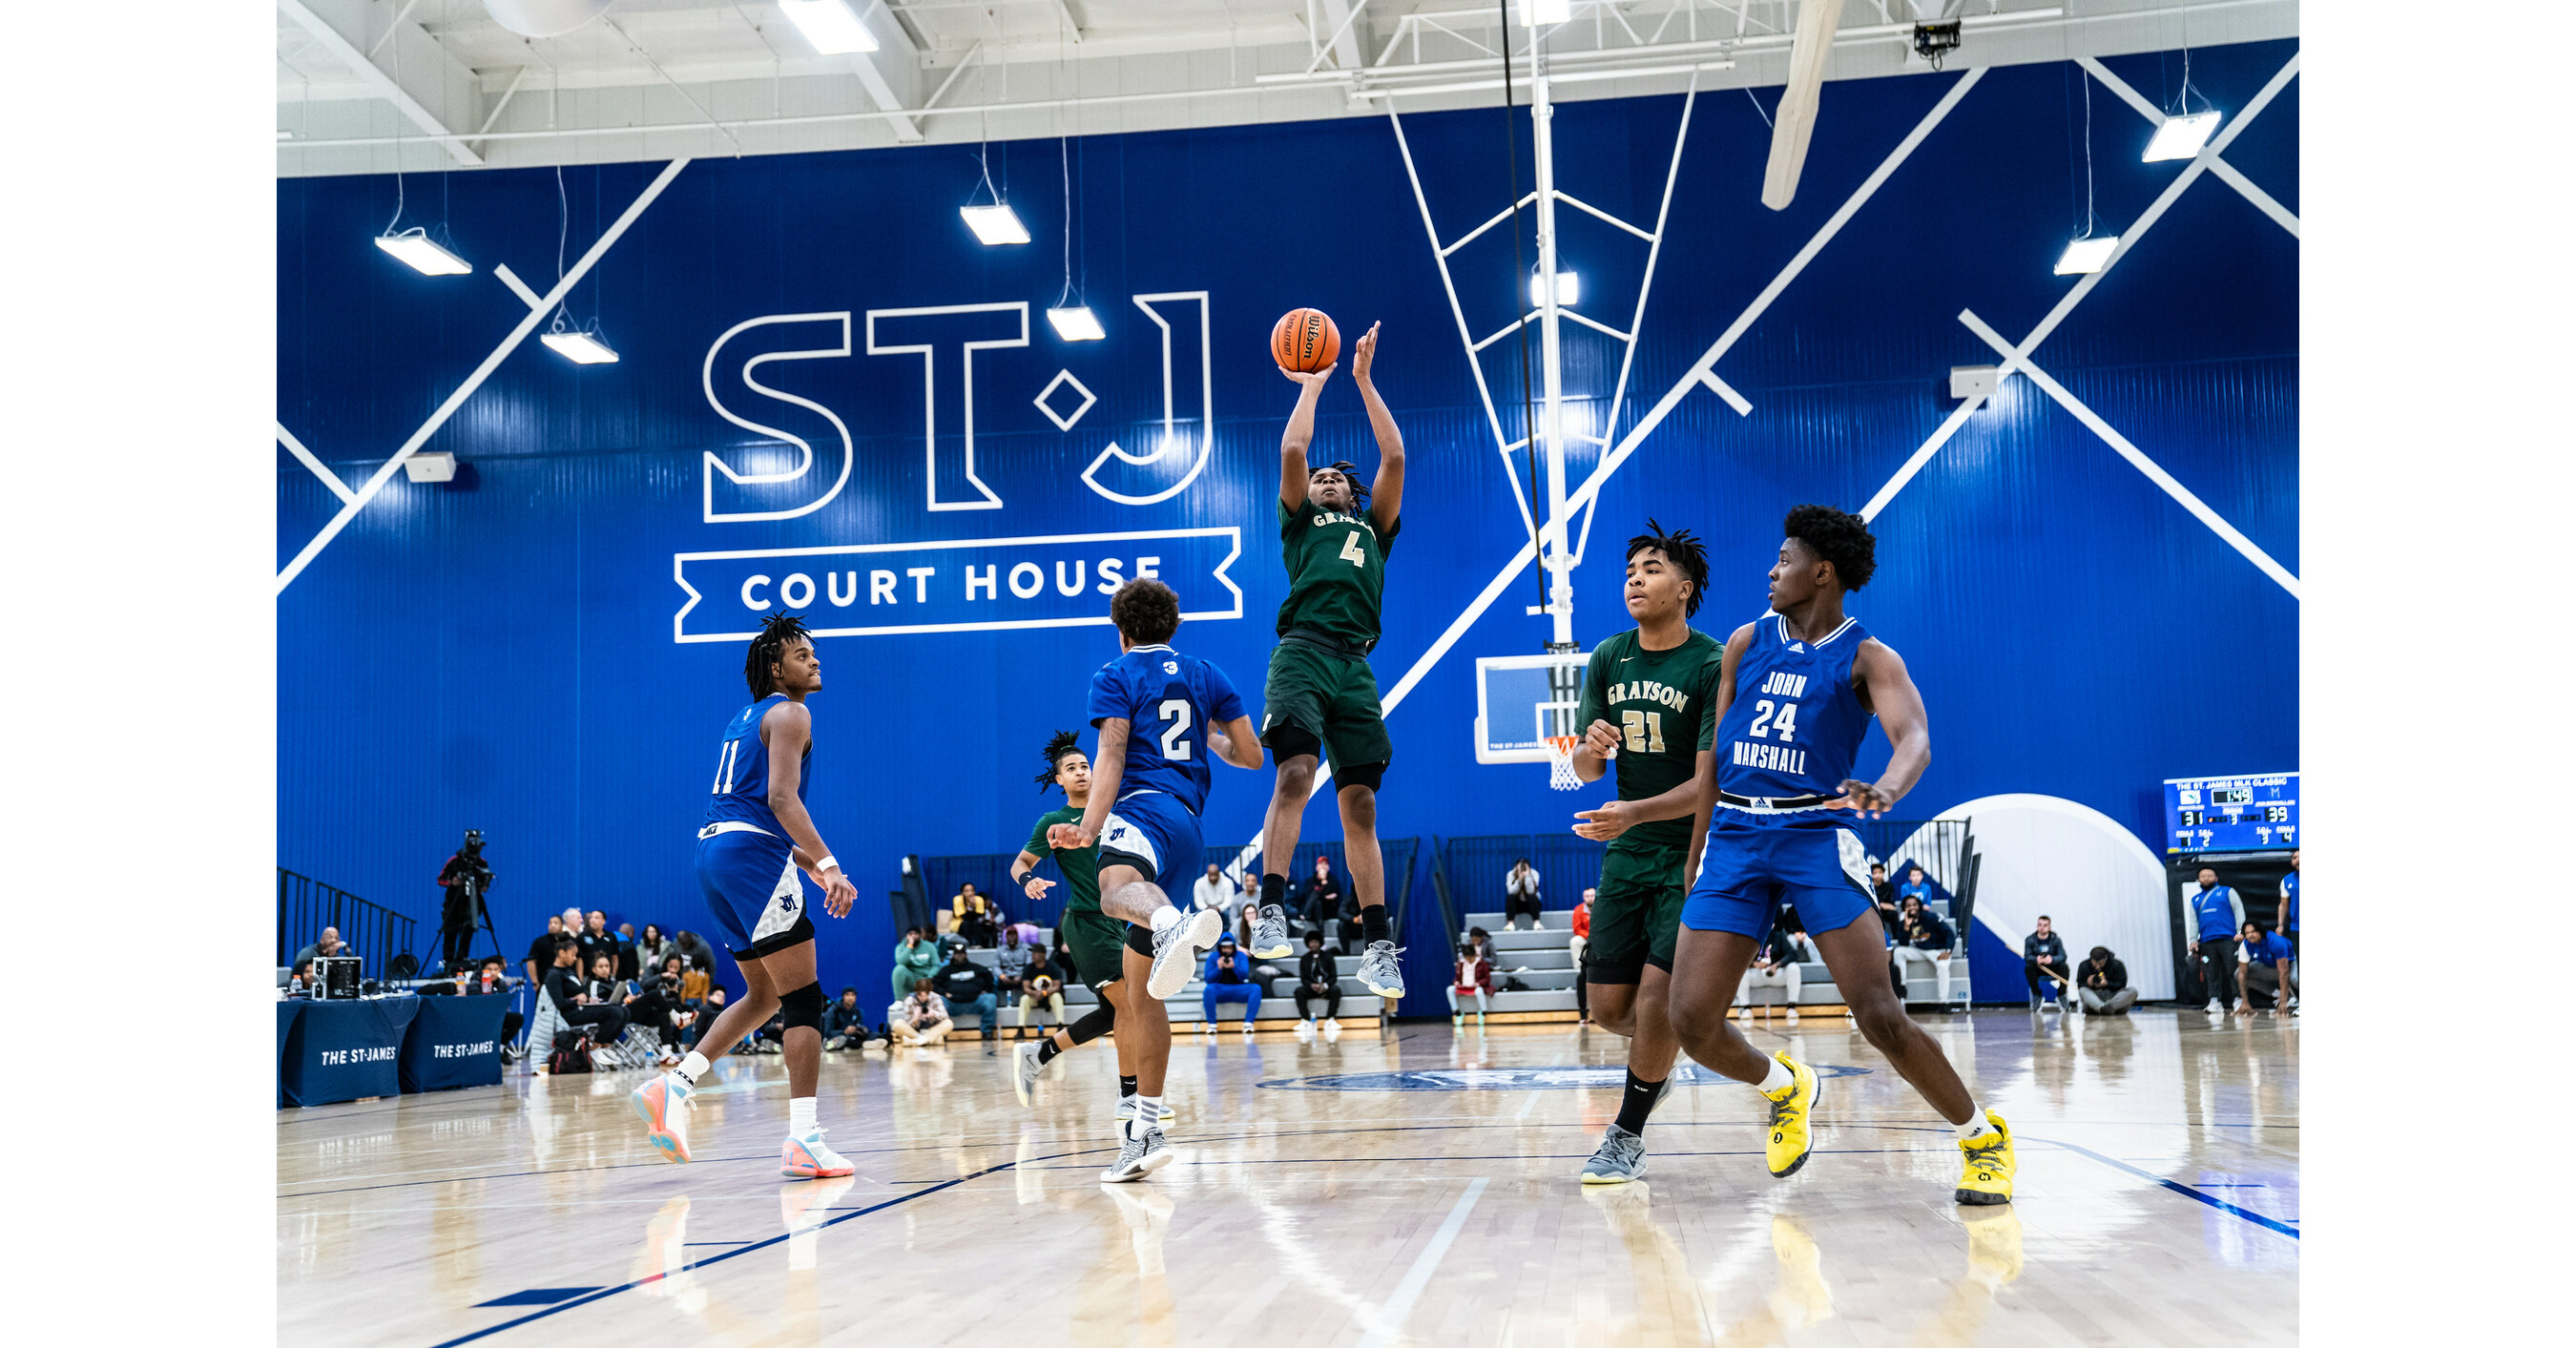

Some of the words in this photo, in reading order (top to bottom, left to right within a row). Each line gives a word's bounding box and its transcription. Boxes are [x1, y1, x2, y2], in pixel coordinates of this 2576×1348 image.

[1303, 315, 1320, 359] Wilson
[1339, 529, 1365, 569] 4
[740, 566, 936, 612] COURT
[1607, 680, 1690, 714] GRAYSON
[1760, 671, 1808, 698] JOHN
[1158, 698, 1192, 760] 2
[1622, 710, 1666, 753] 21
[1749, 698, 1798, 743] 24
[712, 739, 740, 795] 11
[1733, 740, 1806, 776] MARSHALL
[2176, 782, 2192, 791] THE
[2206, 779, 2233, 790] JAMES
[2233, 778, 2251, 787] MLK
[2253, 777, 2287, 787] CLASSIC
[2185, 811, 2203, 827] 31
[2231, 814, 2238, 826] 3
[2269, 806, 2288, 822] 39
[322, 1050, 347, 1067] THE
[434, 1045, 453, 1059] THE
